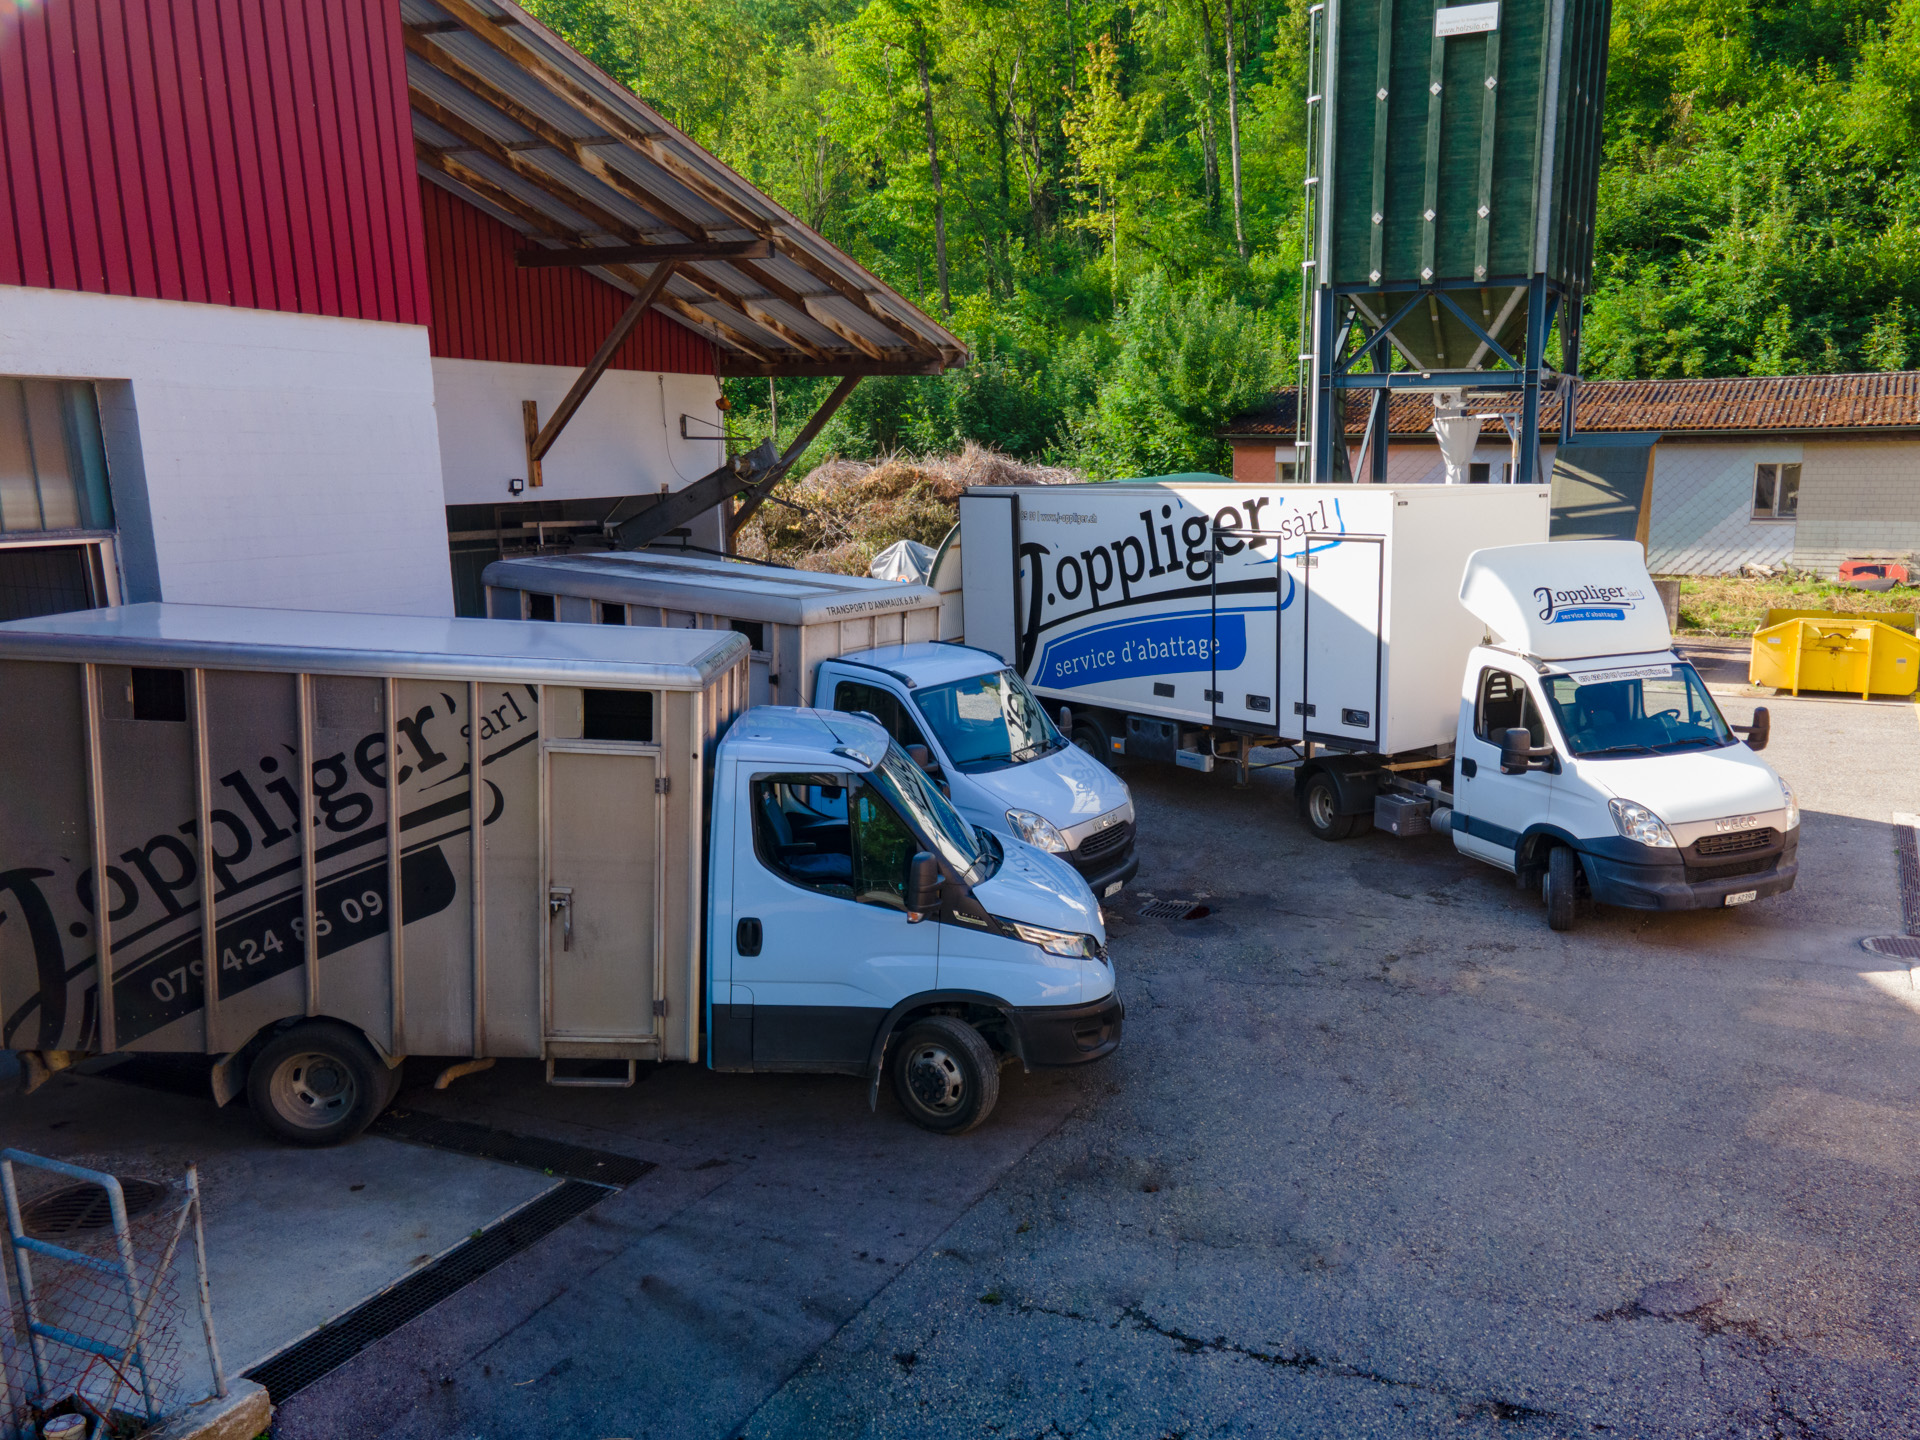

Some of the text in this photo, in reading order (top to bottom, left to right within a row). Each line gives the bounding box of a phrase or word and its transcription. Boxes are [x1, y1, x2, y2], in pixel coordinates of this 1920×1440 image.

[1438, 22, 1489, 34] www.holzsilo.ch
[1281, 500, 1329, 540] sàrl
[826, 602, 868, 616] TRANSPORT
[868, 597, 904, 611] D'ANIMAUX
[1533, 585, 1625, 621] J.oppliger
[1561, 611, 1618, 620] service d'abattage
[1055, 637, 1220, 677] service d'abattage
[1714, 816, 1758, 832] IVECO
[222, 929, 284, 971] 424
[340, 890, 383, 924] 09
